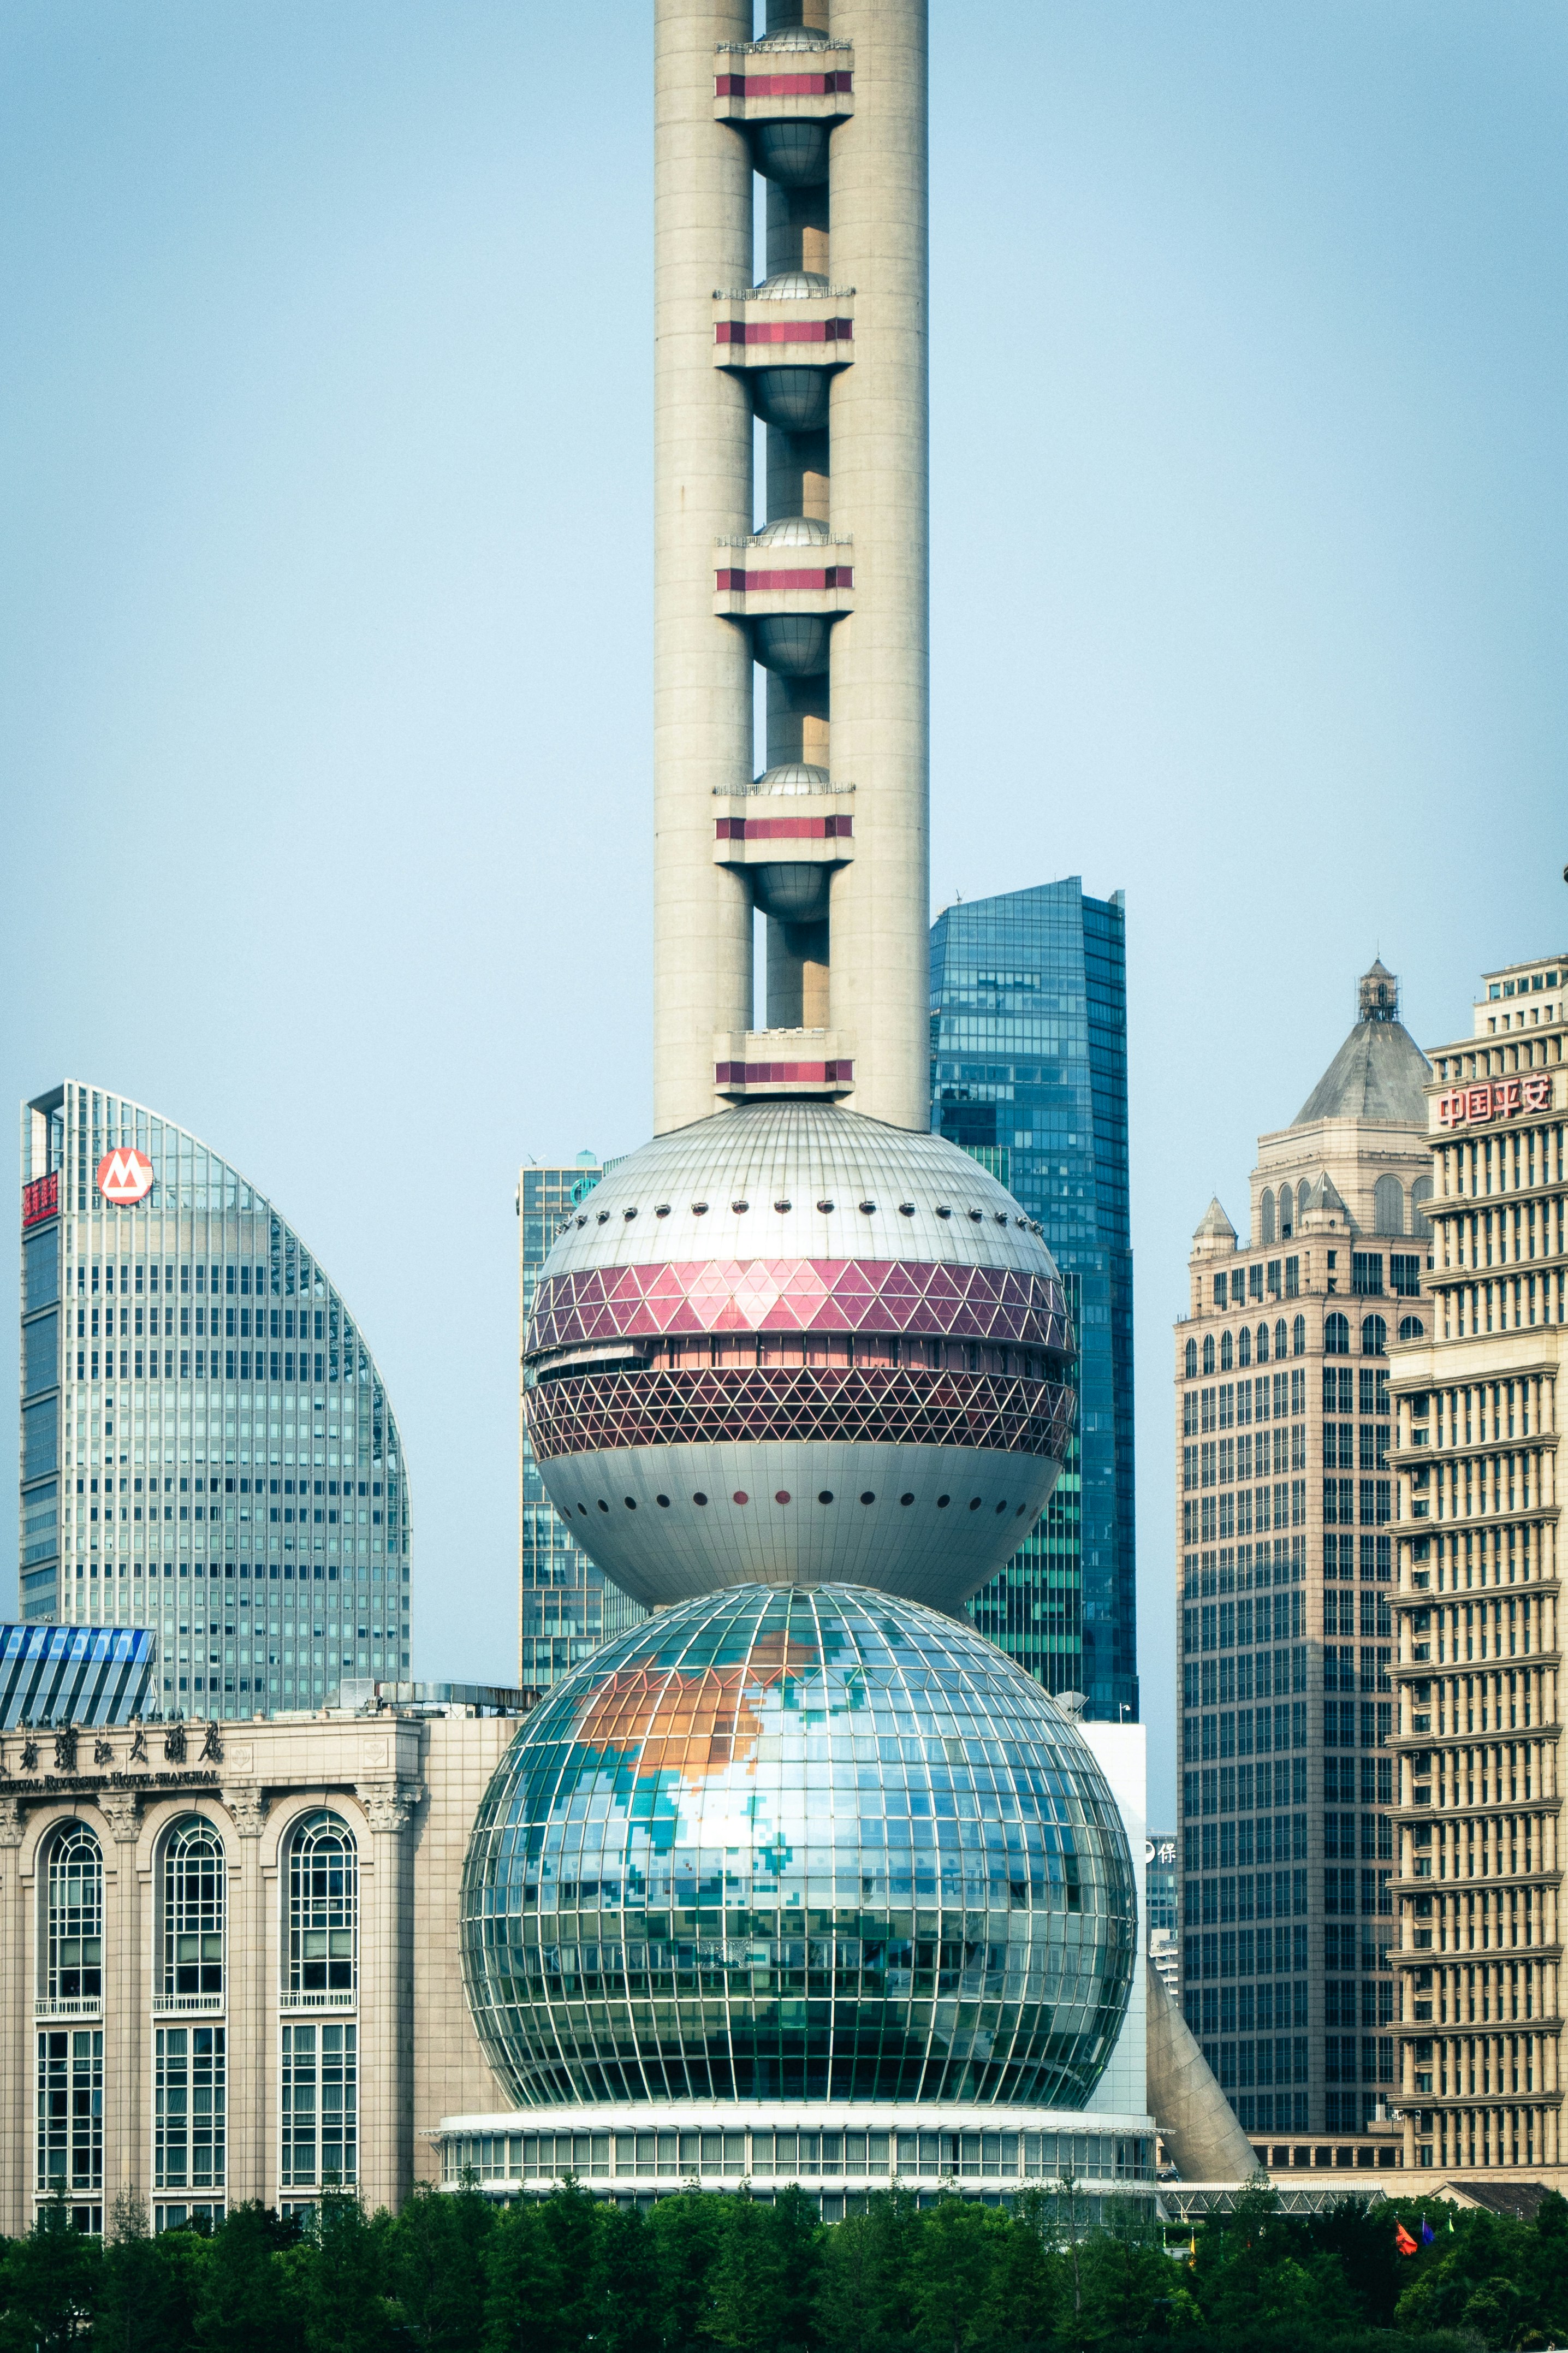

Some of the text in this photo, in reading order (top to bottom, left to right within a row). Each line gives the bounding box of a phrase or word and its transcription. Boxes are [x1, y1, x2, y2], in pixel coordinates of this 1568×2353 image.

[1437, 1073, 1551, 1128] 中国平安
[1157, 1843, 1176, 1864] 保
